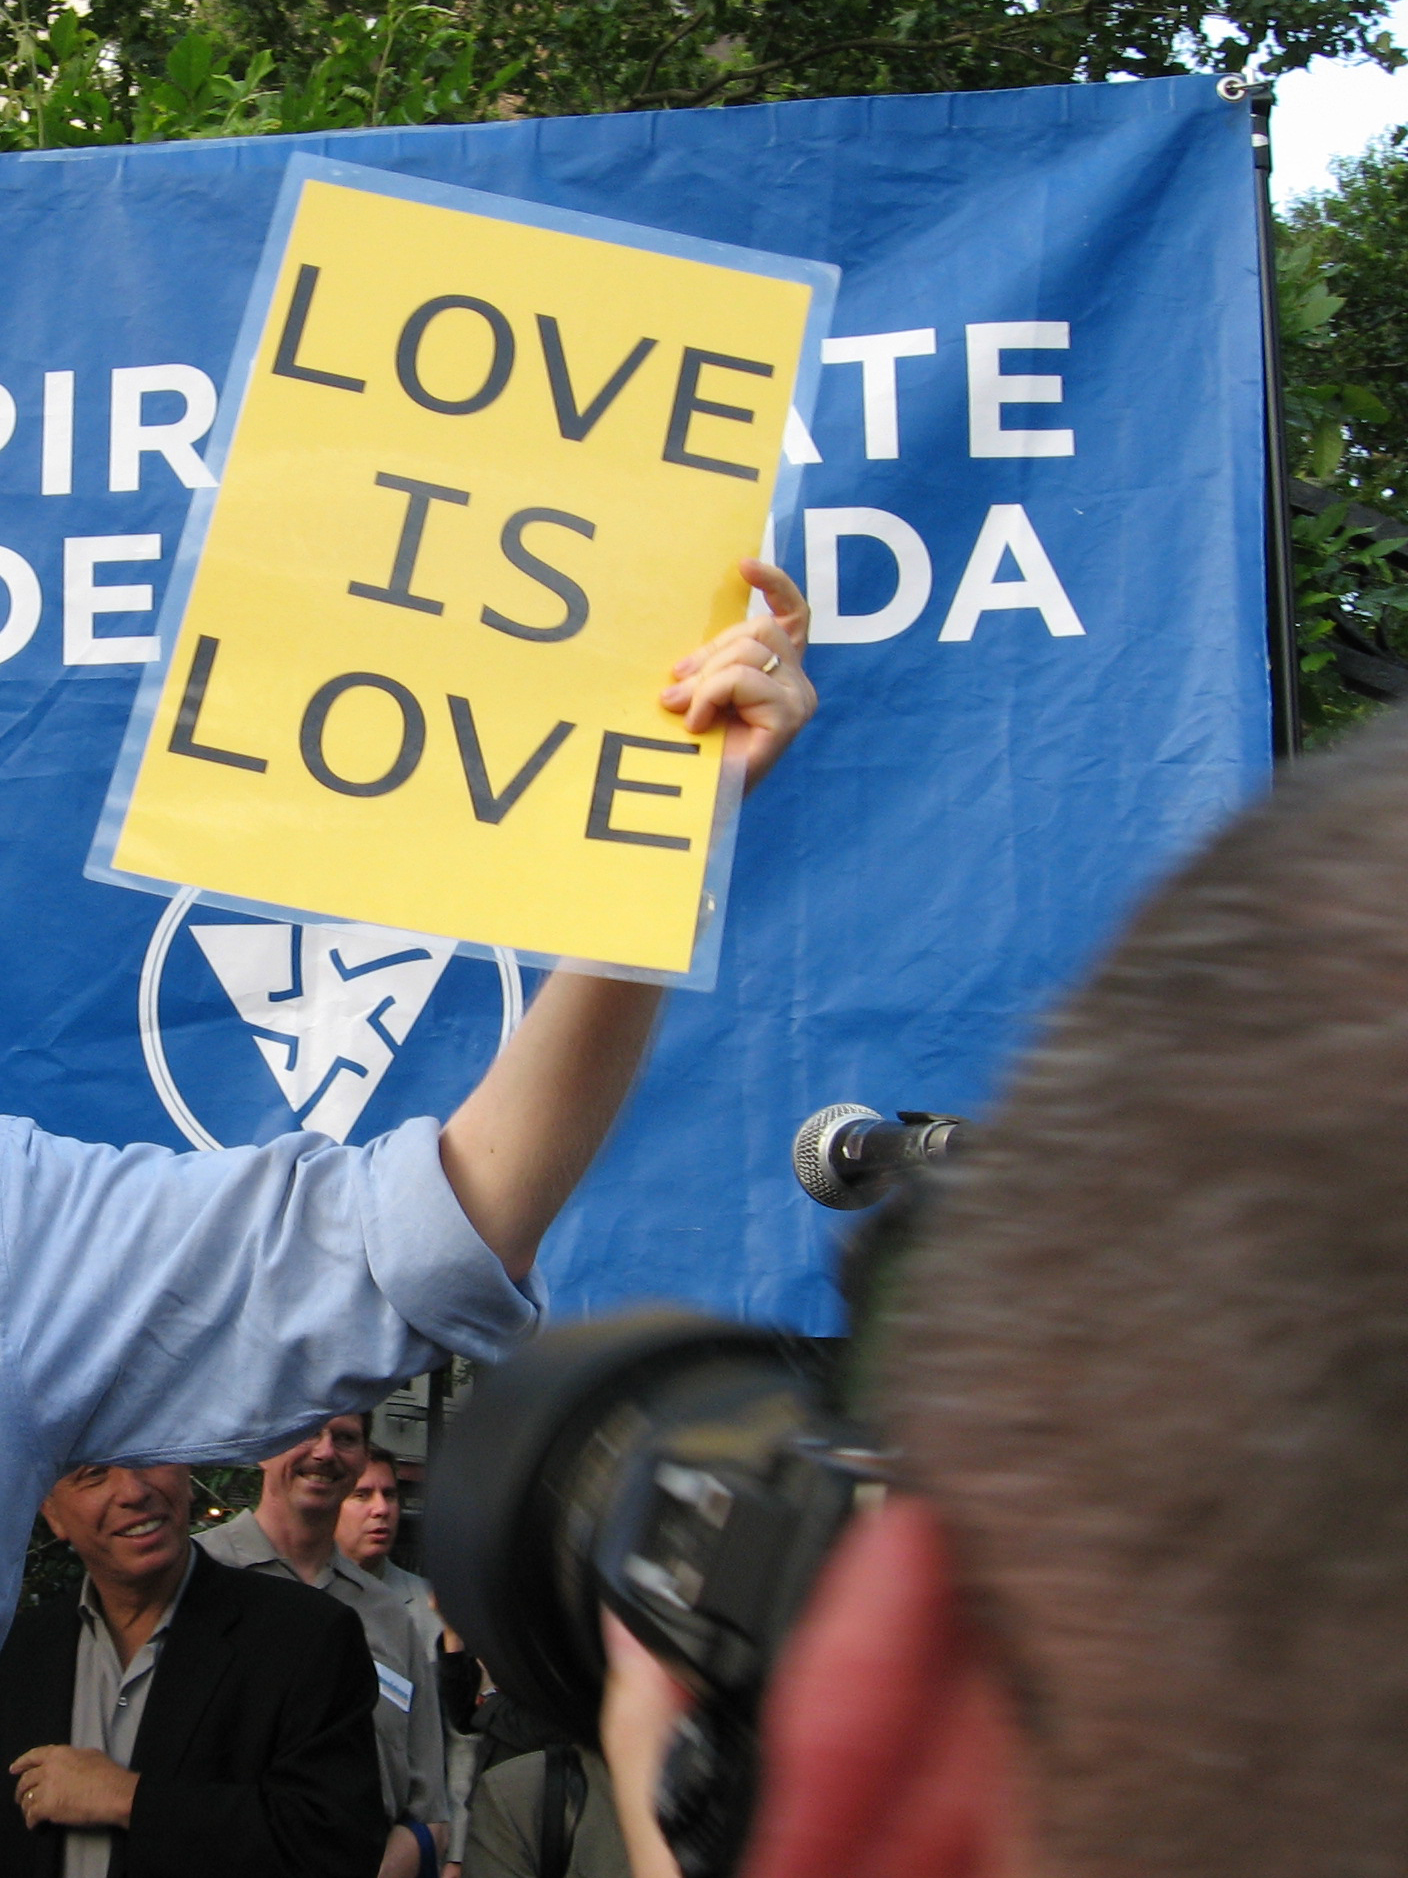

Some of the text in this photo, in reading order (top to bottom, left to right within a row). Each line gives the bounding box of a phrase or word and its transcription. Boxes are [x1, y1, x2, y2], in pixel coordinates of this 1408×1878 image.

[271, 263, 775, 484] LOVE
[347, 471, 597, 644] IS
[166, 634, 703, 852] LOVE
